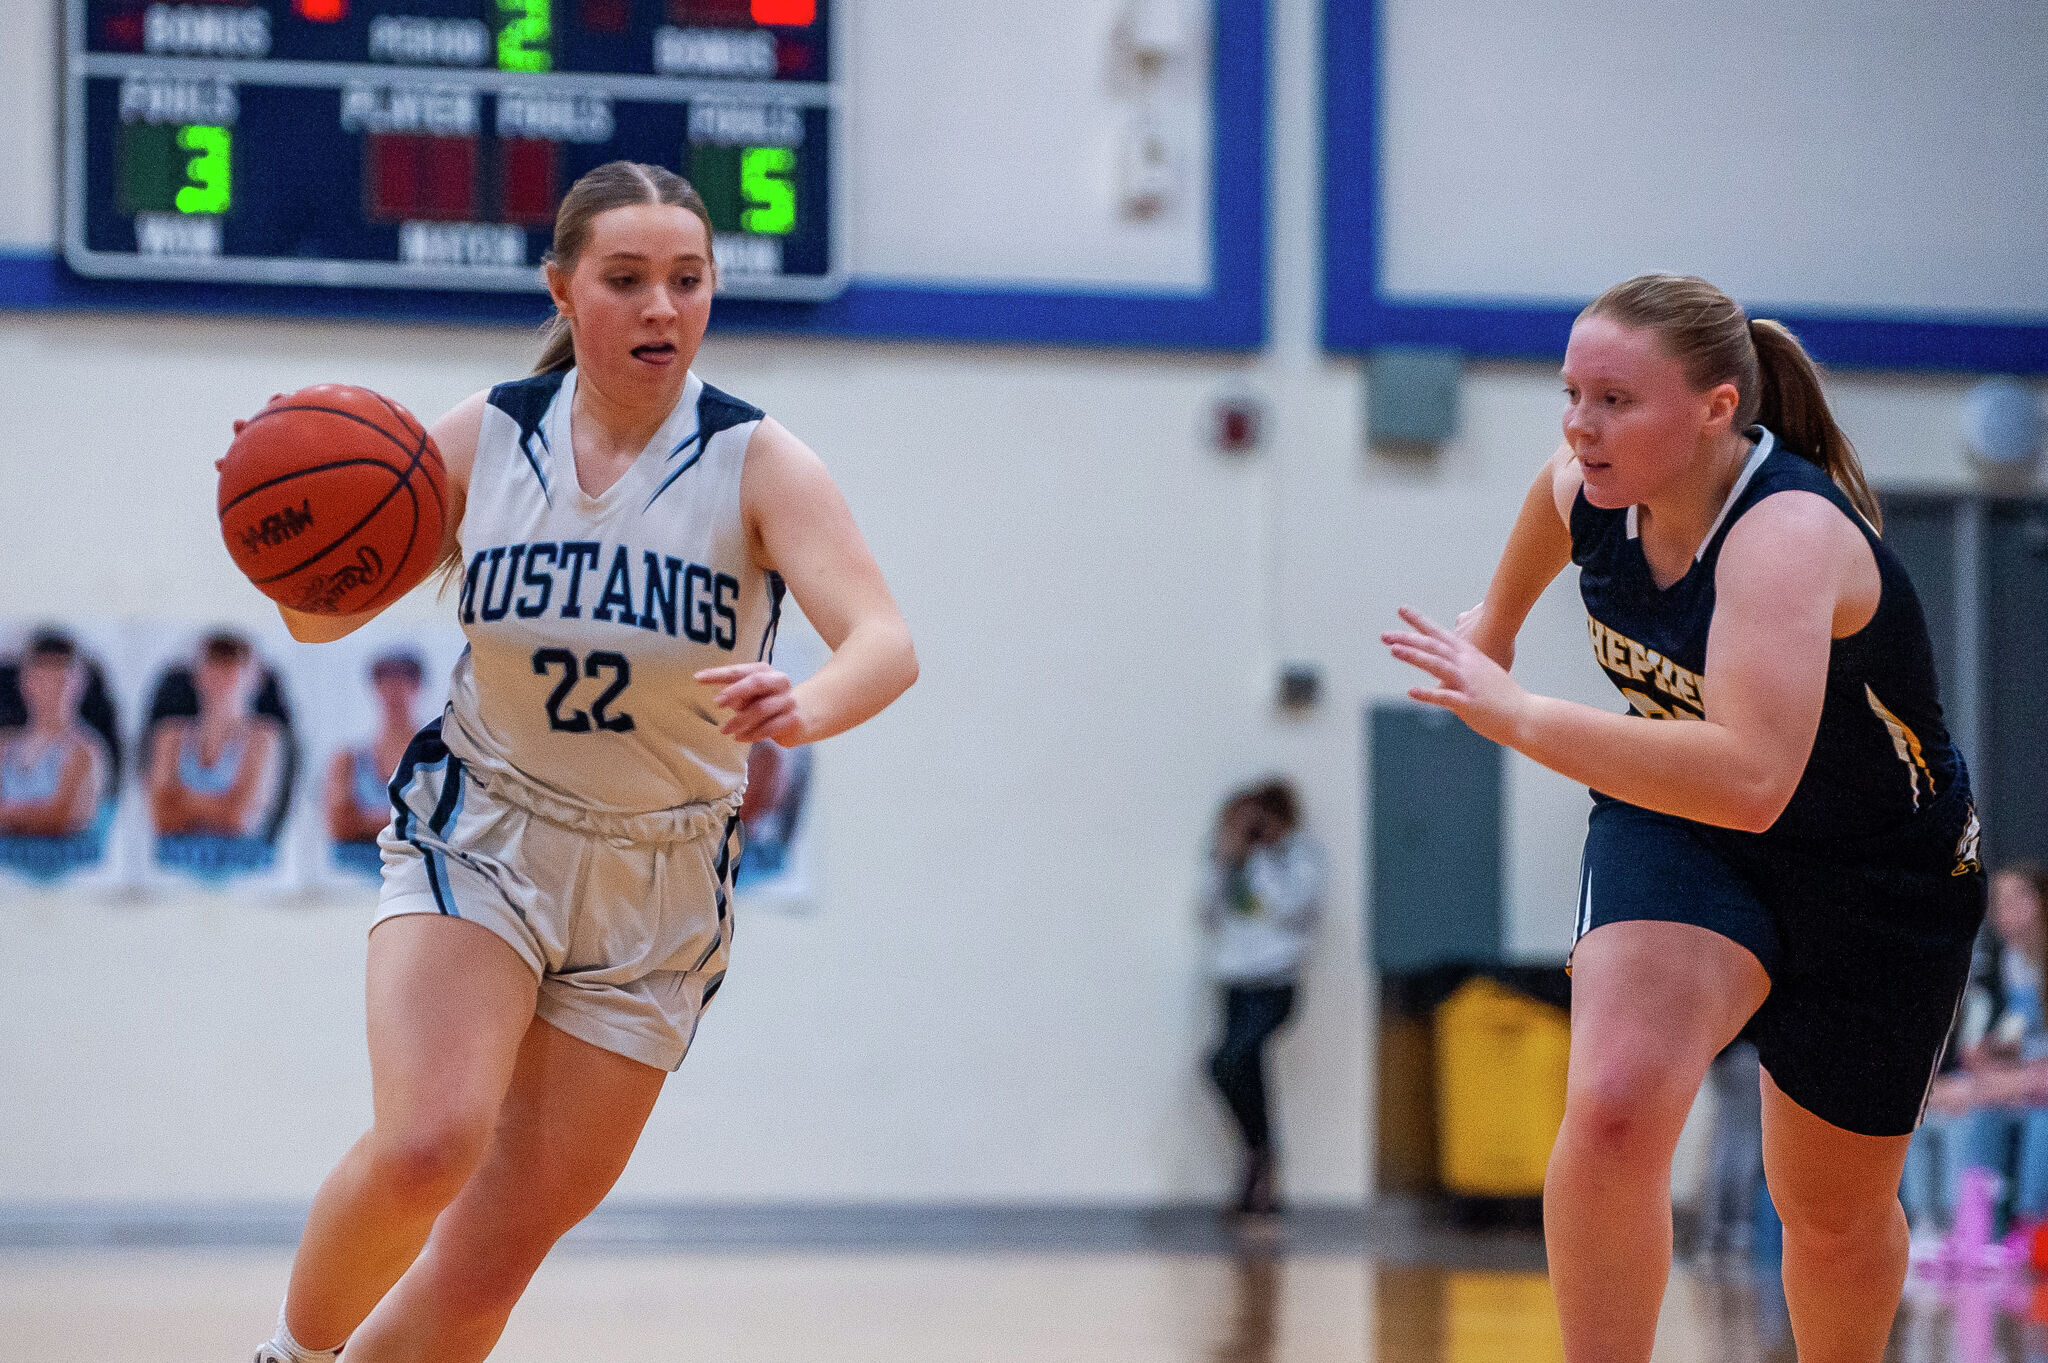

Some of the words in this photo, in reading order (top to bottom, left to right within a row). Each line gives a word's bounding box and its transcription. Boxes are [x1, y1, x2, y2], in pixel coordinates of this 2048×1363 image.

[498, 0, 552, 72] 2
[176, 126, 232, 214] 3
[741, 147, 796, 235] 5
[532, 648, 635, 732] 22
